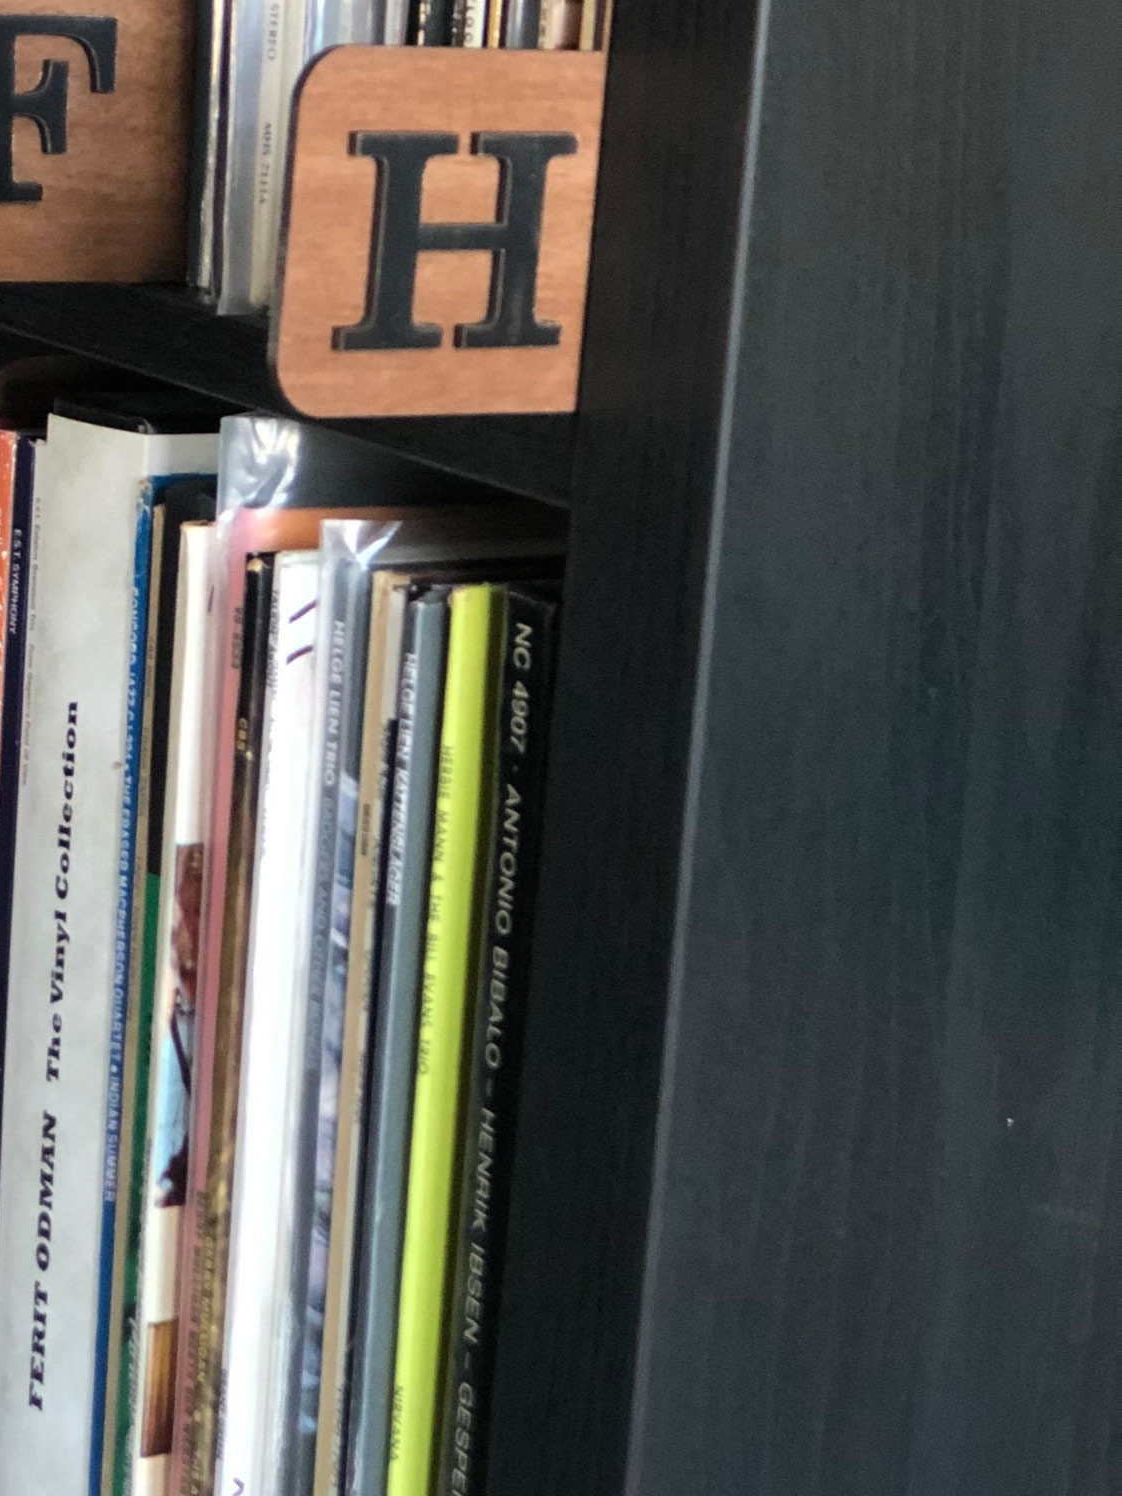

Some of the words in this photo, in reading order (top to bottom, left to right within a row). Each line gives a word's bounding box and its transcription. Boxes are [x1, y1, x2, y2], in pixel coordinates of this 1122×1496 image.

[267, 3, 280, 62] STEREO
[332, 133, 575, 354] H
[7, 563, 20, 634] SYMPHONY
[328, 620, 345, 686] HELGE
[513, 621, 533, 671] NC
[326, 690, 341, 736] LIEN
[399, 651, 418, 718] HELGE
[509, 680, 529, 753] 4907
[324, 740, 339, 786] TRIO
[396, 718, 413, 760] LIEN
[51, 701, 78, 901] Collection
[434, 810, 449, 861] MANN
[495, 782, 522, 935] ANTONIO
[313, 888, 329, 928] AND
[429, 893, 443, 922] THE
[47, 909, 69, 1005] Vinyl
[426, 933, 438, 961] BILL
[109, 989, 123, 1061] QUARTET
[422, 971, 436, 1026] EVANS
[484, 945, 509, 1069] BIBALO
[43, 1014, 64, 1082] The
[418, 1038, 431, 1075] TRIO
[107, 1076, 120, 1128] INDIAN
[32, 1111, 57, 1272] ODMAN
[103, 1132, 117, 1201] SUMMER
[472, 1107, 496, 1230] HENRIK
[464, 1242, 485, 1341] IBSEN
[25, 1280, 50, 1410] FERIT
[390, 1384, 405, 1462] NIRVANA
